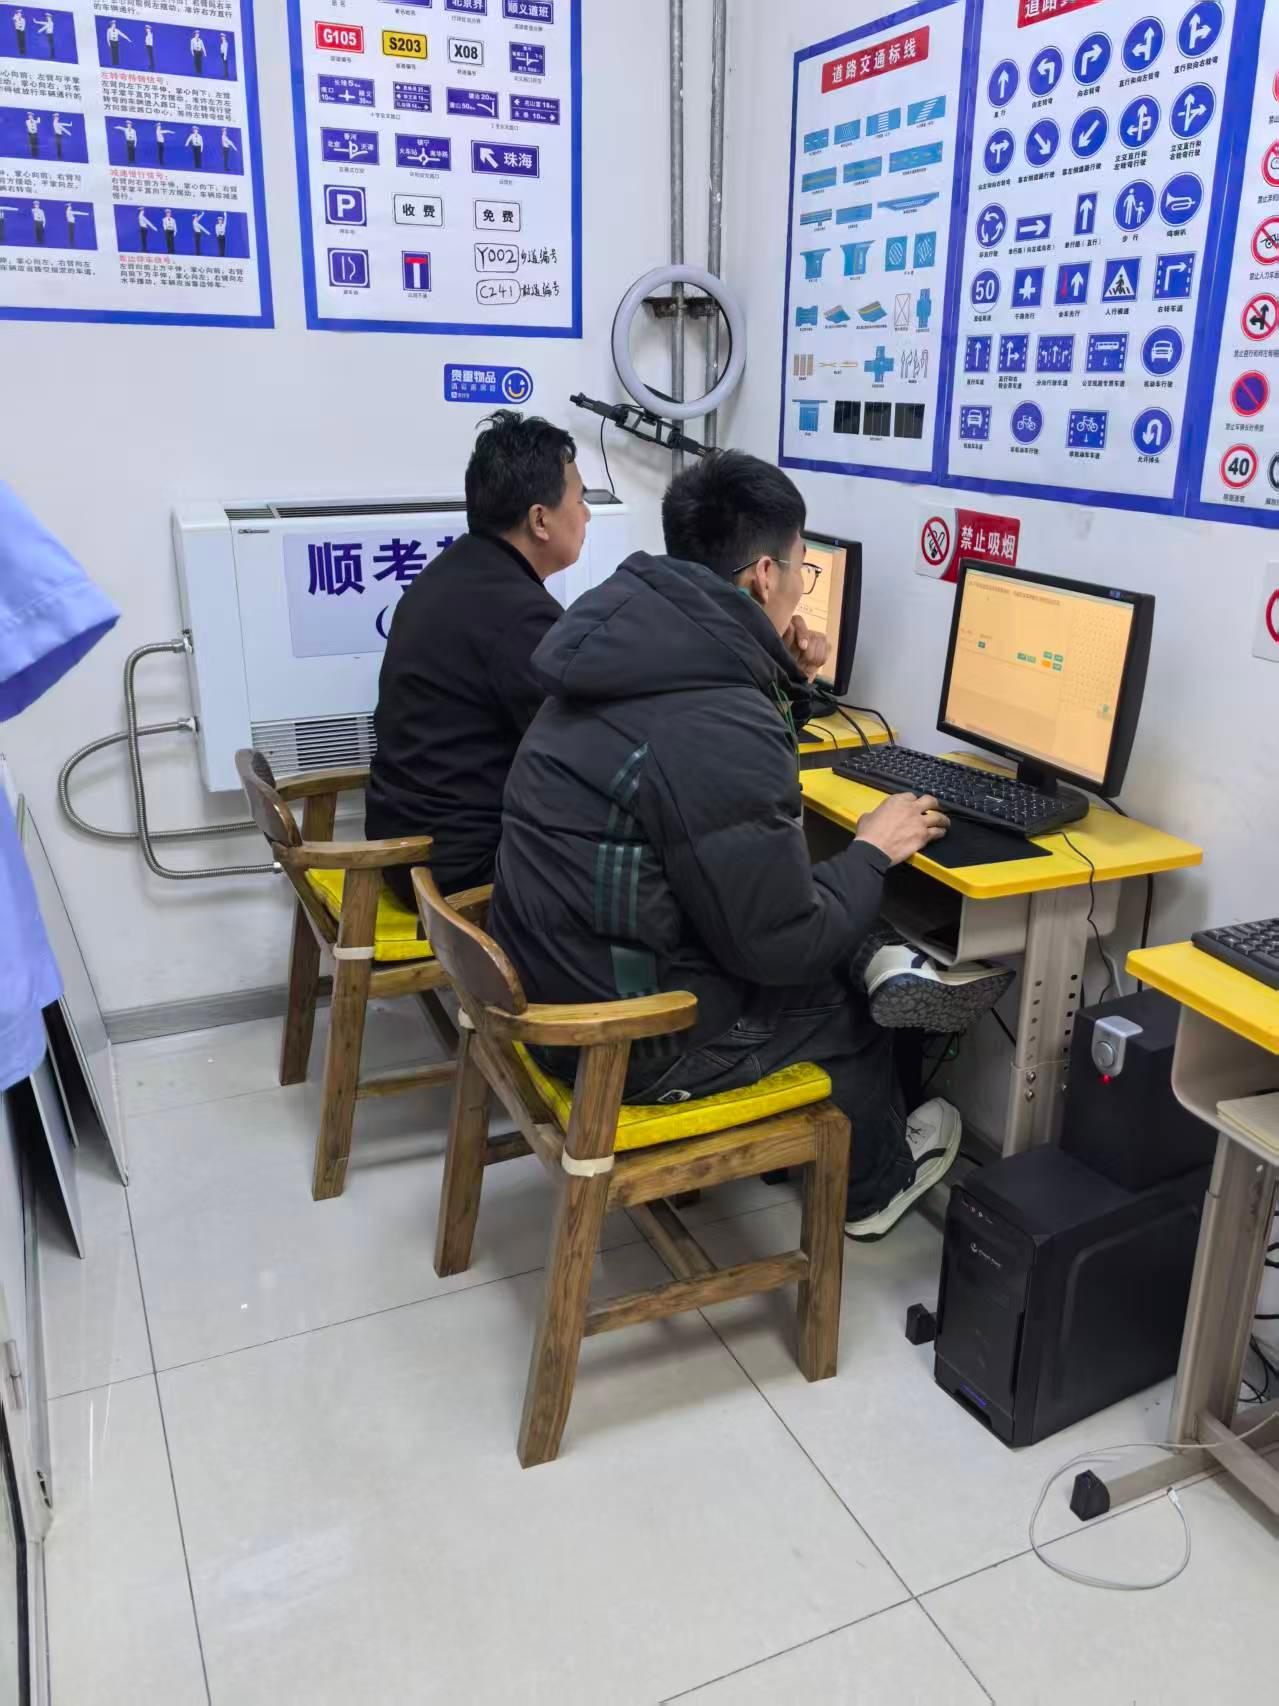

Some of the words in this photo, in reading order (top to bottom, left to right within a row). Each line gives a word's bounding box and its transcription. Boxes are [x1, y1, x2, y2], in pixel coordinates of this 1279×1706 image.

[507, 1, 550, 18] 顺义道班
[1024, 0, 1067, 18] 道路
[322, 28, 357, 46] G105
[389, 37, 421, 53] S203
[454, 44, 478, 59] X08
[831, 37, 917, 84] 道路交通标线
[1173, 56, 1219, 74] 直行和向右转弯
[1118, 71, 1160, 87] 直行和向左转弯
[1077, 86, 1101, 98] 向右转弯
[1031, 98, 1053, 109] 向左转弯
[993, 110, 1006, 118] 直行
[1170, 140, 1201, 152] 立交直行和
[503, 152, 533, 169] 珠海
[1114, 150, 1147, 162] 立交直行和
[1169, 149, 1201, 160] 右转弯行驶
[1113, 159, 1146, 170] 左转弯行驶
[336, 193, 356, 218] P
[402, 203, 436, 218] 收费
[482, 209, 514, 223] 免费
[476, 246, 517, 270] Y002
[479, 284, 513, 299] C241
[975, 279, 996, 301] 50
[1105, 307, 1130, 316] 人行横道
[1157, 305, 1184, 313] 右转车道
[451, 369, 497, 383] 贵重物品
[1227, 457, 1250, 477] 40
[960, 525, 1016, 561] 禁止吸烟
[307, 535, 457, 597] 顺考
